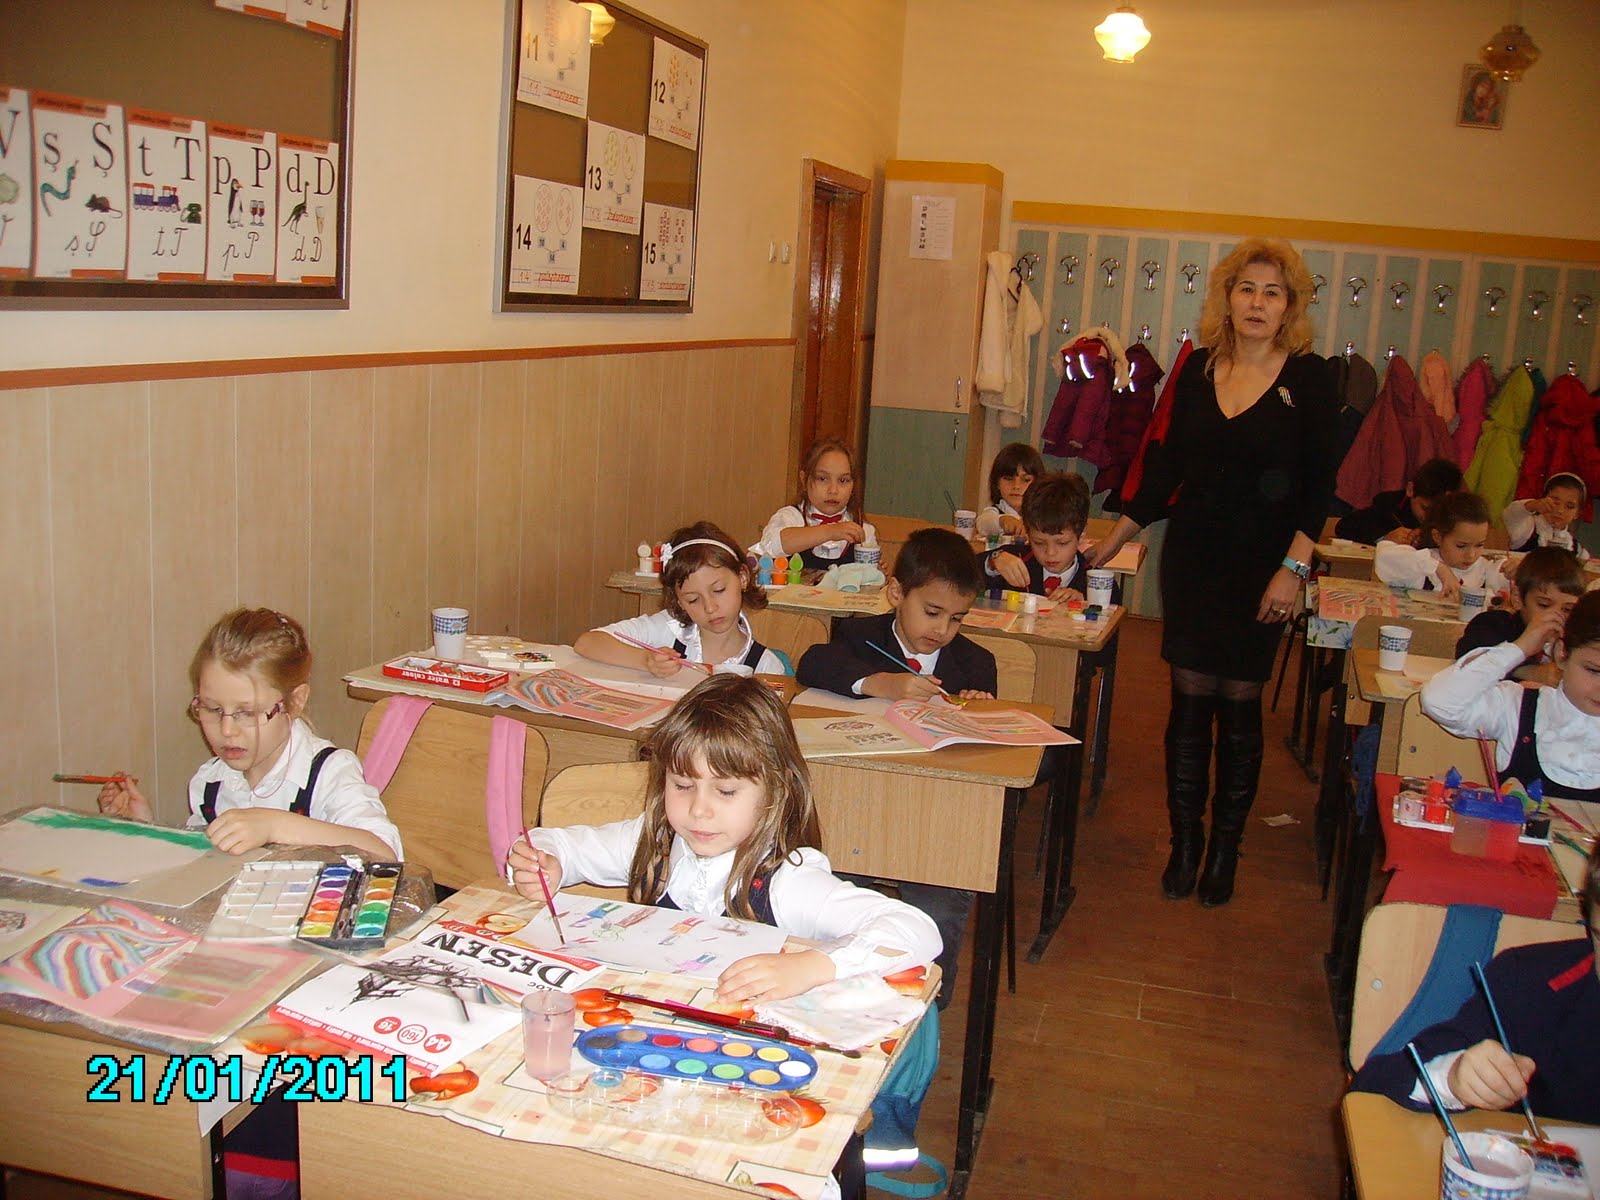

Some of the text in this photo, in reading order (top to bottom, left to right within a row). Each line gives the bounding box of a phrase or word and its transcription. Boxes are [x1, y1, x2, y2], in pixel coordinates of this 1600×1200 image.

[525, 32, 539, 61] 11
[653, 78, 666, 104] 12
[137, 135, 202, 181] t T
[213, 146, 272, 195] p P
[286, 153, 336, 196] d D
[588, 165, 602, 192] 13
[515, 223, 532, 251] 14
[644, 242, 657, 265] 15
[401, 670, 427, 681] colour
[427, 674, 450, 685] water
[421, 932, 580, 989] DESEN
[401, 1029, 420, 1042] 160
[424, 1036, 451, 1051] A4
